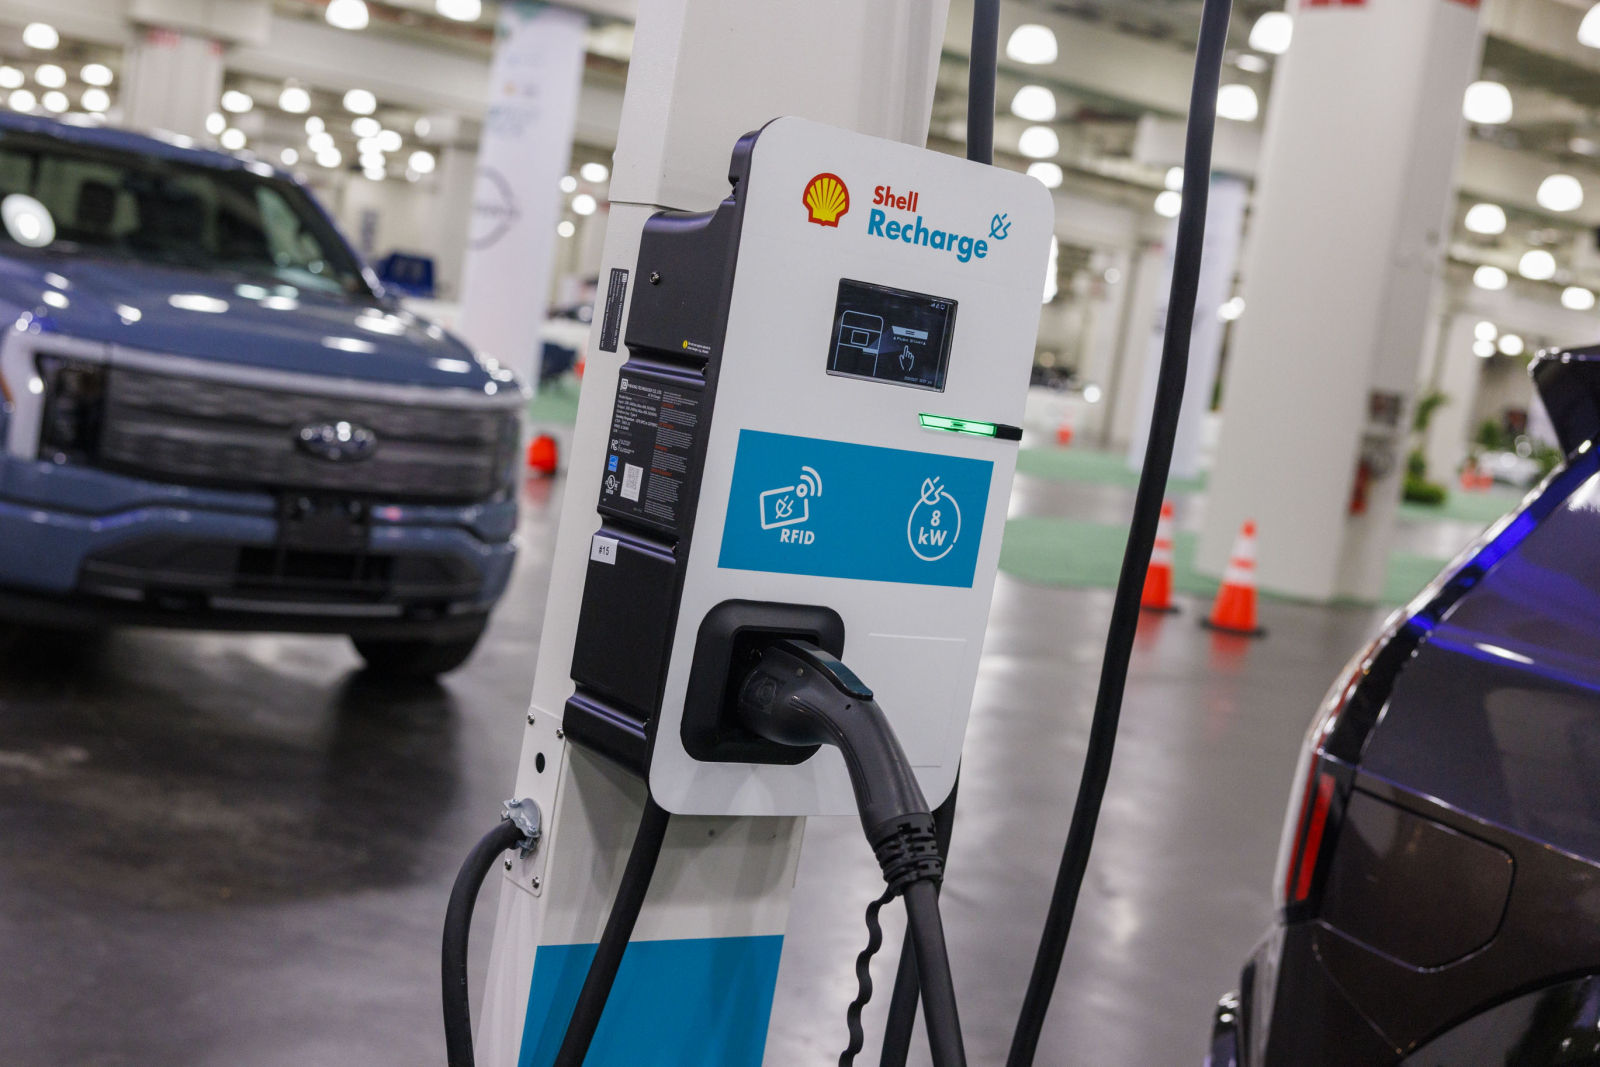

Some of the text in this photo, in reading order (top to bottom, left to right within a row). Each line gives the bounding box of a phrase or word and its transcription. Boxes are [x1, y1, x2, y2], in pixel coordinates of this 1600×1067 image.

[872, 185, 919, 213] Shell
[867, 208, 989, 264] Recharge
[930, 509, 941, 527] 8
[779, 527, 816, 545] RFID
[917, 526, 948, 546] kW
[598, 546, 610, 556] #15
